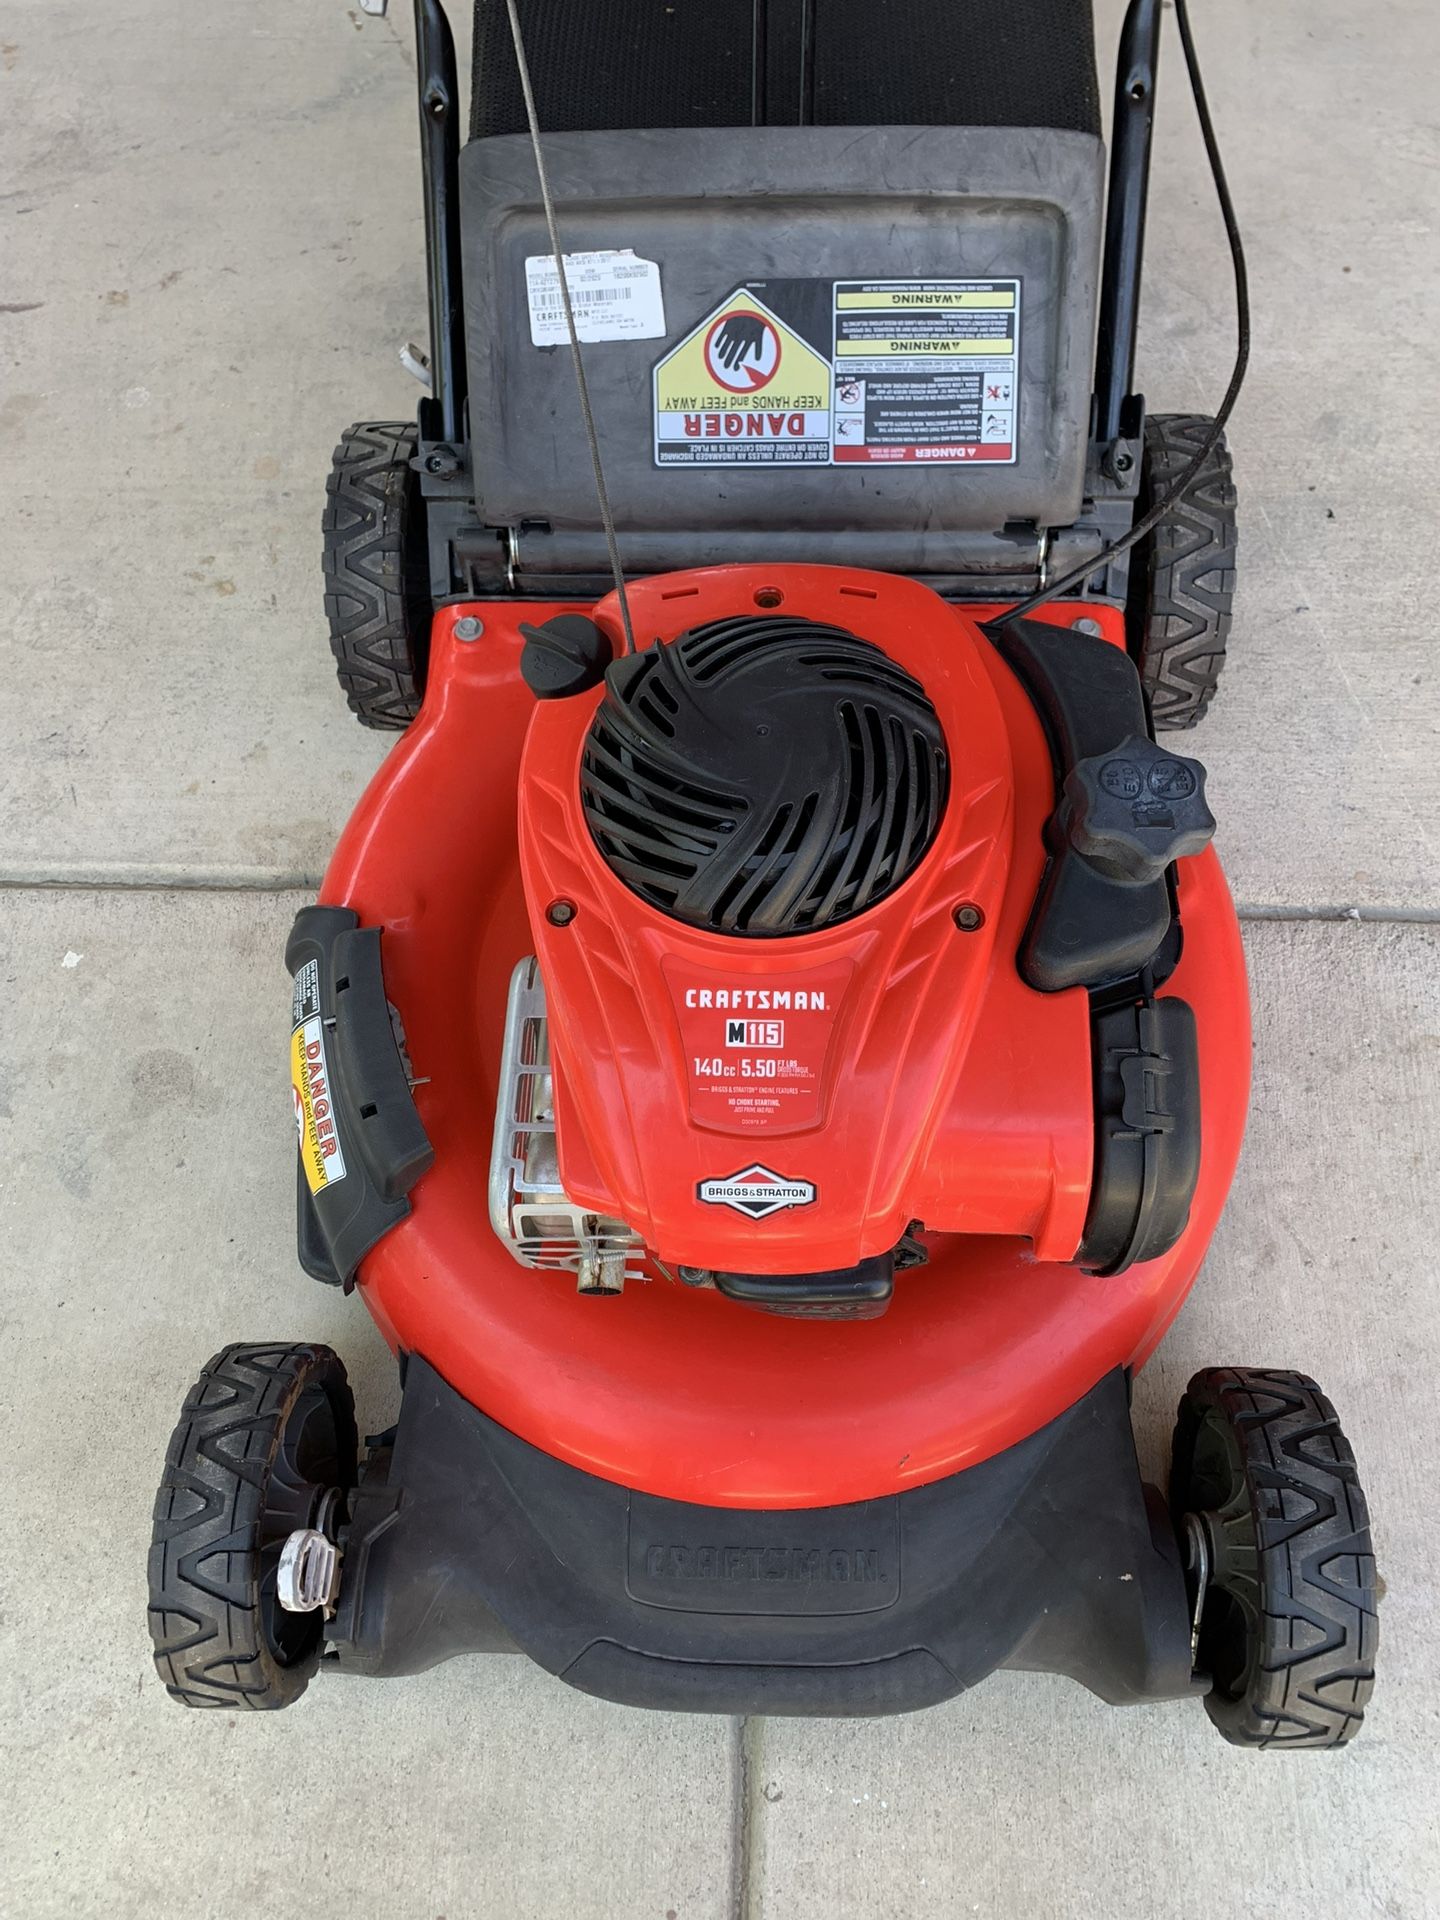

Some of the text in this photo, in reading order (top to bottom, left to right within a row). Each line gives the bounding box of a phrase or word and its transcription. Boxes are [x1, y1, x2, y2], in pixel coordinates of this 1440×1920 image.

[892, 295, 952, 303] WARNING
[890, 342, 950, 350] WARNING
[665, 396, 822, 409] KEEP HANDS and FEET AWAY
[684, 413, 804, 436] DANGER
[688, 444, 709, 452] PLACE.
[710, 444, 717, 452] IN
[719, 444, 725, 452] IS
[727, 444, 754, 452] CATCHER
[808, 443, 828, 451] COVER
[696, 452, 736, 460] UNDAMAGED
[737, 452, 747, 460] AN
[748, 452, 773, 460] UNLESS
[916, 448, 965, 457] DANGER
[311, 963, 315, 971] DO
[685, 989, 825, 1011] CRAFTSMAN
[729, 1022, 780, 1044] M115
[694, 1057, 776, 1077] 140cc 5.50
[306, 1040, 337, 1159] DANGER
[297, 1033, 326, 1181] KEEP HANDS and FEET AWAY
[647, 1544, 879, 1583] CRAFTSMAN
